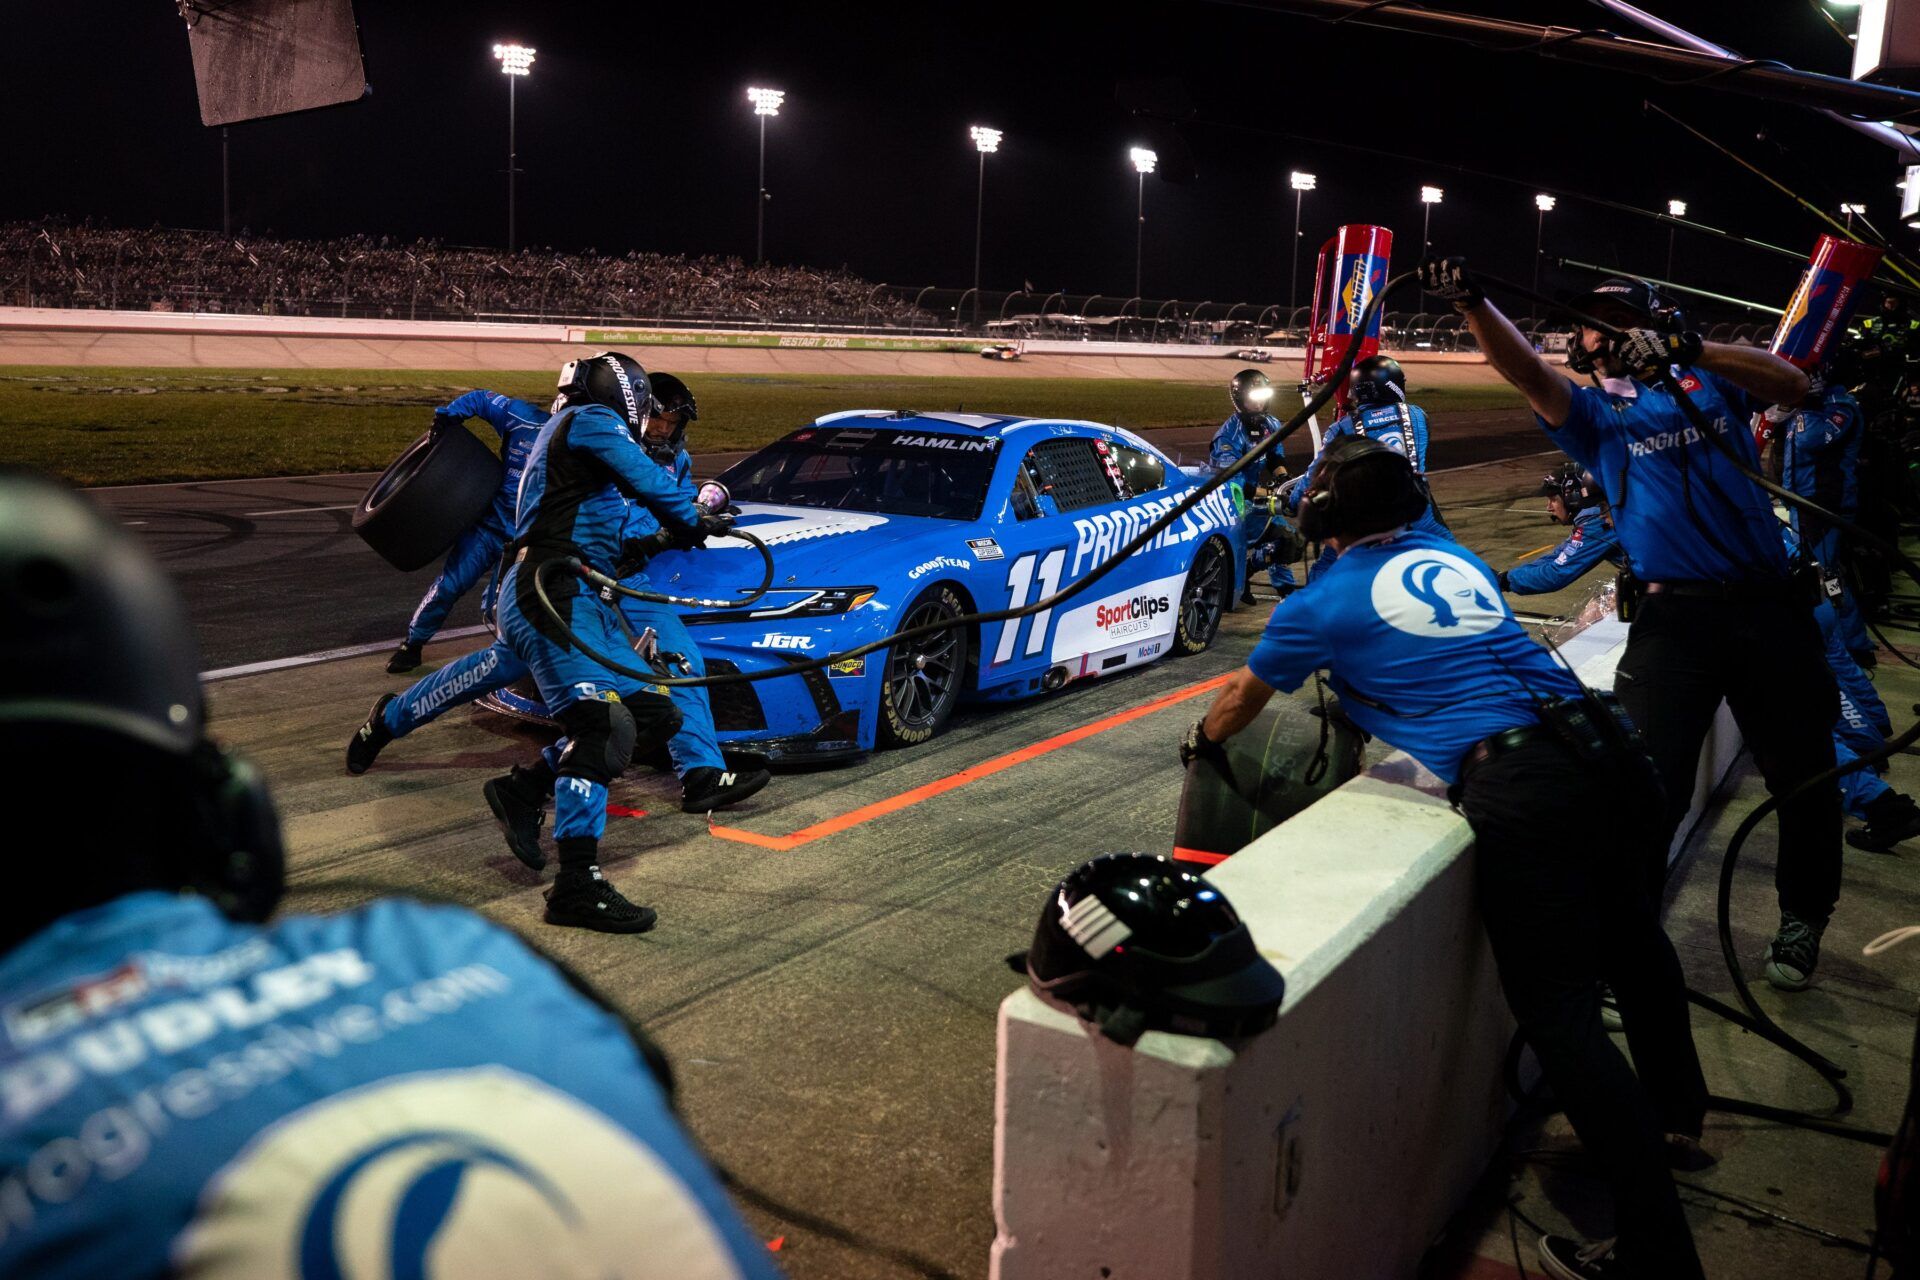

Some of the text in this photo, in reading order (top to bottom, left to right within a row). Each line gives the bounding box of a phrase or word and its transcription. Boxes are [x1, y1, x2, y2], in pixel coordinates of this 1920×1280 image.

[779, 337, 849, 347] RESTART ZONE
[602, 356, 639, 425] PROGRESSIVE
[892, 435, 987, 452] HAMLIN
[908, 556, 971, 580] GOODYEAR
[993, 549, 1067, 663] 11
[1111, 620, 1148, 637] HAIRCUTS
[751, 632, 816, 649] JGR
[1137, 644, 1155, 658] Mobil
[832, 659, 863, 670] SUNOCO
[411, 649, 499, 720] PROGRESSIVE
